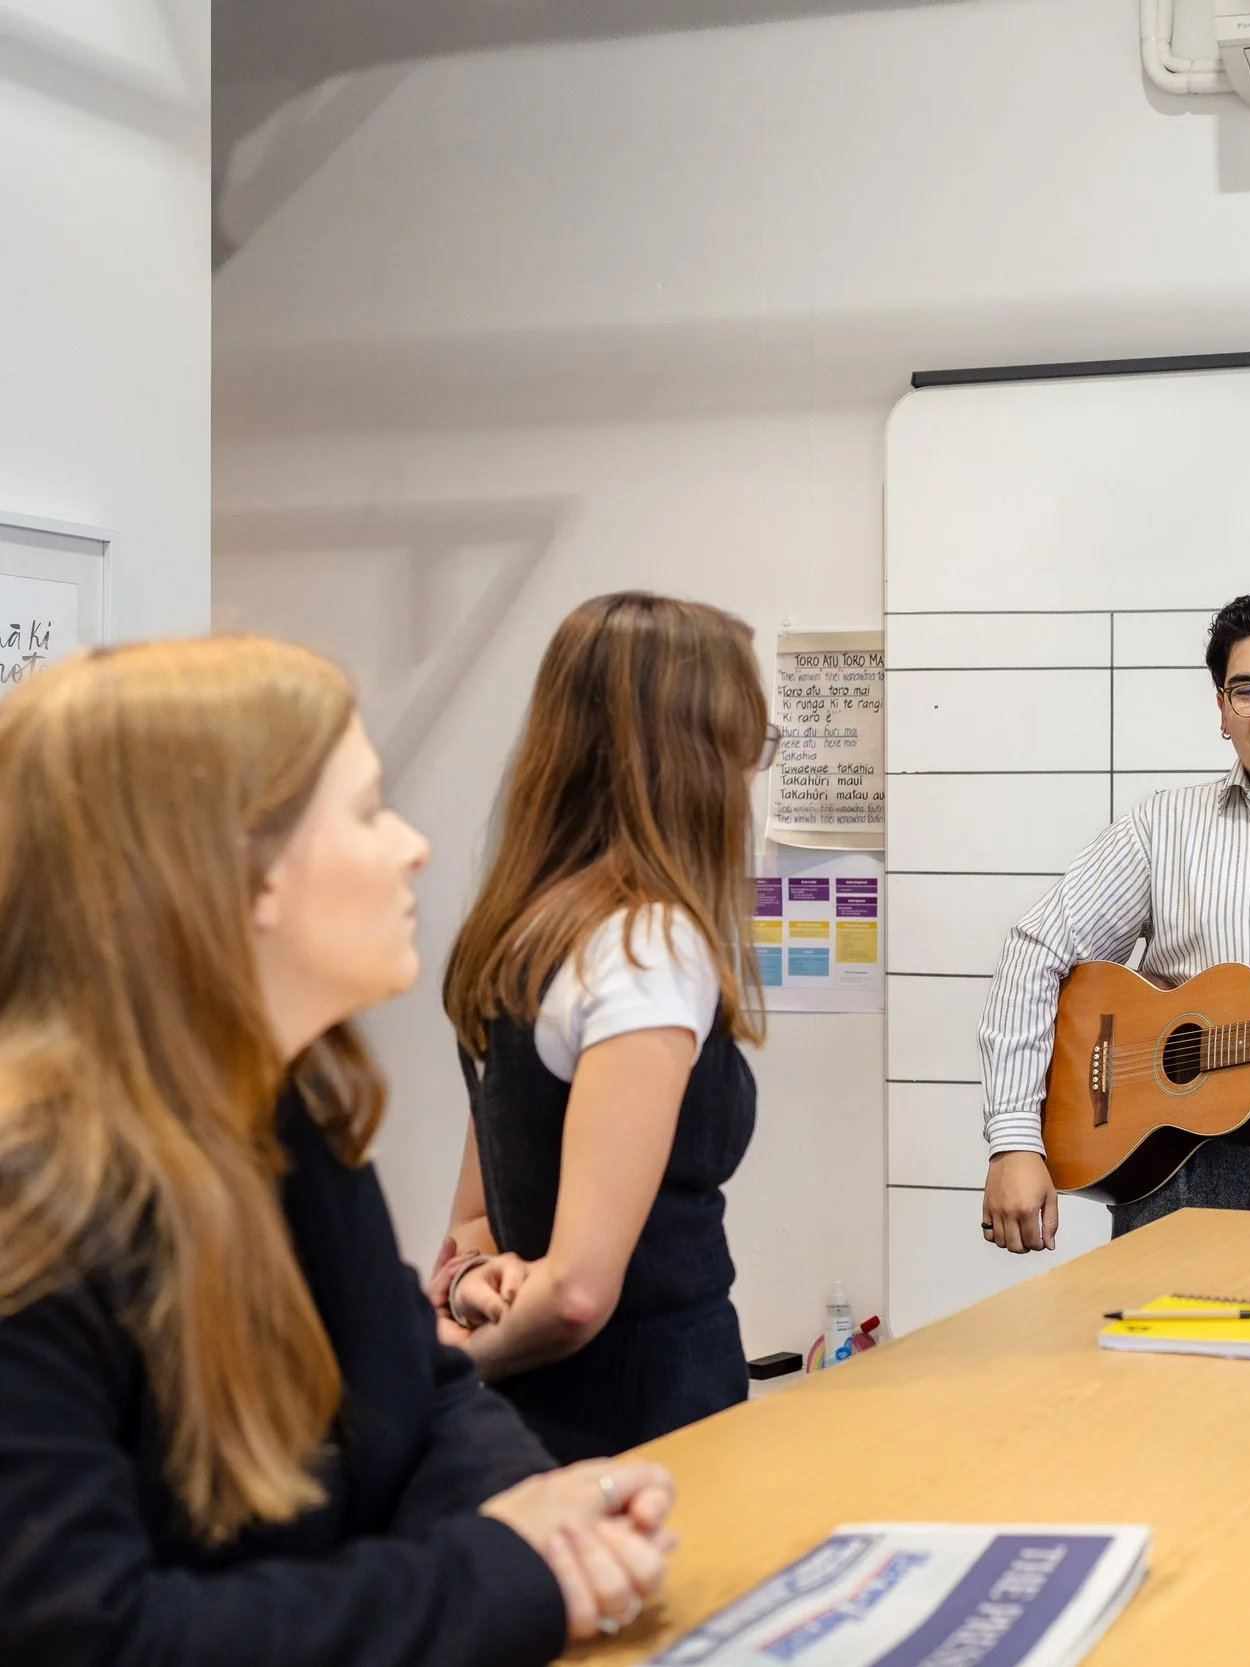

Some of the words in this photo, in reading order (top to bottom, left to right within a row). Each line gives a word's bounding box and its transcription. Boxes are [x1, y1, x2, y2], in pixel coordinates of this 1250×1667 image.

[794, 653, 820, 667] TORO
[822, 653, 839, 668] ATU
[842, 652, 866, 667] TORO
[782, 685, 803, 697] Toro
[806, 685, 820, 696] atu
[828, 684, 849, 696] toro
[853, 685, 870, 696] mai
[796, 699, 825, 714] runga
[844, 699, 853, 709] te
